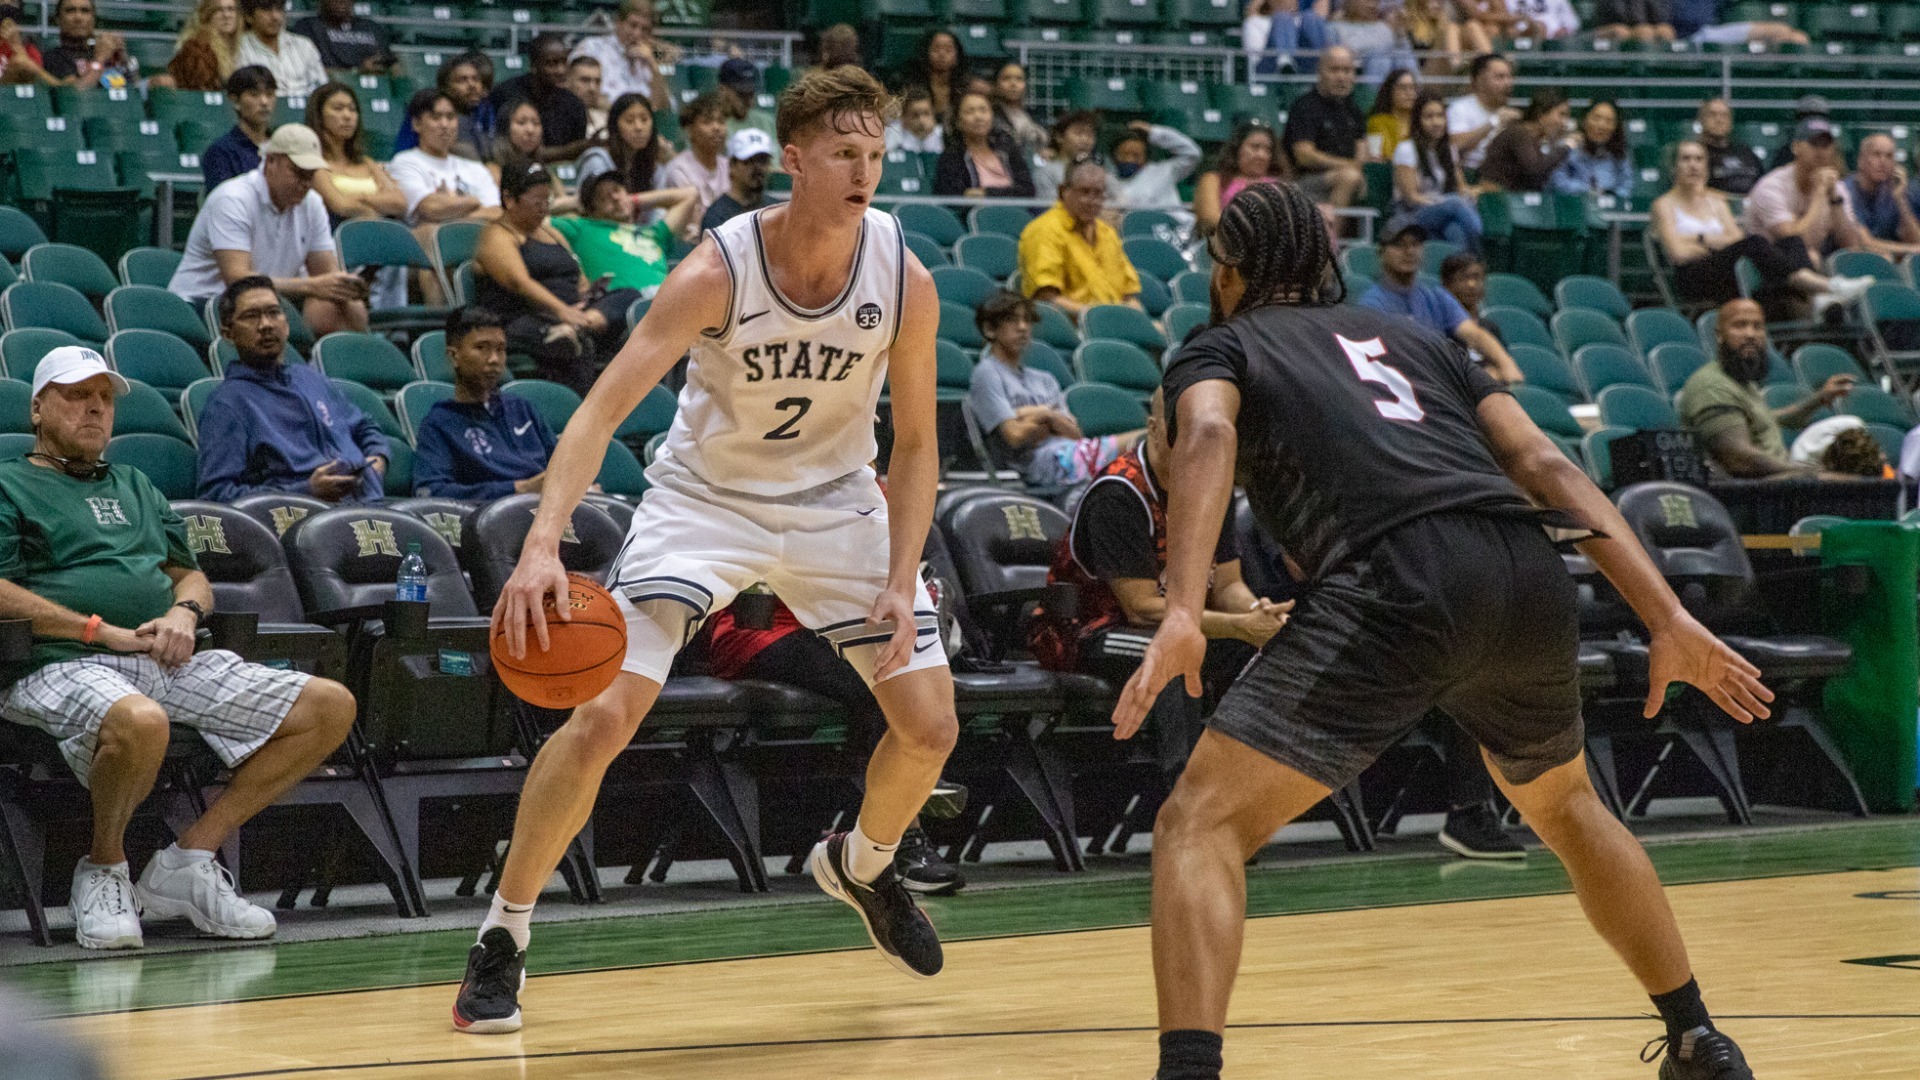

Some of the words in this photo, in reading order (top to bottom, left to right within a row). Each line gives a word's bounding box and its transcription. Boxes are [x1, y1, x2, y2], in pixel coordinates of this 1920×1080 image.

[859, 313, 880, 327] 33
[742, 340, 865, 382] STATE
[1333, 332, 1425, 423] 5
[762, 396, 813, 440] 2
[85, 497, 131, 526] H
[1001, 505, 1047, 541] H
[184, 514, 232, 554] H
[349, 519, 403, 557] H
